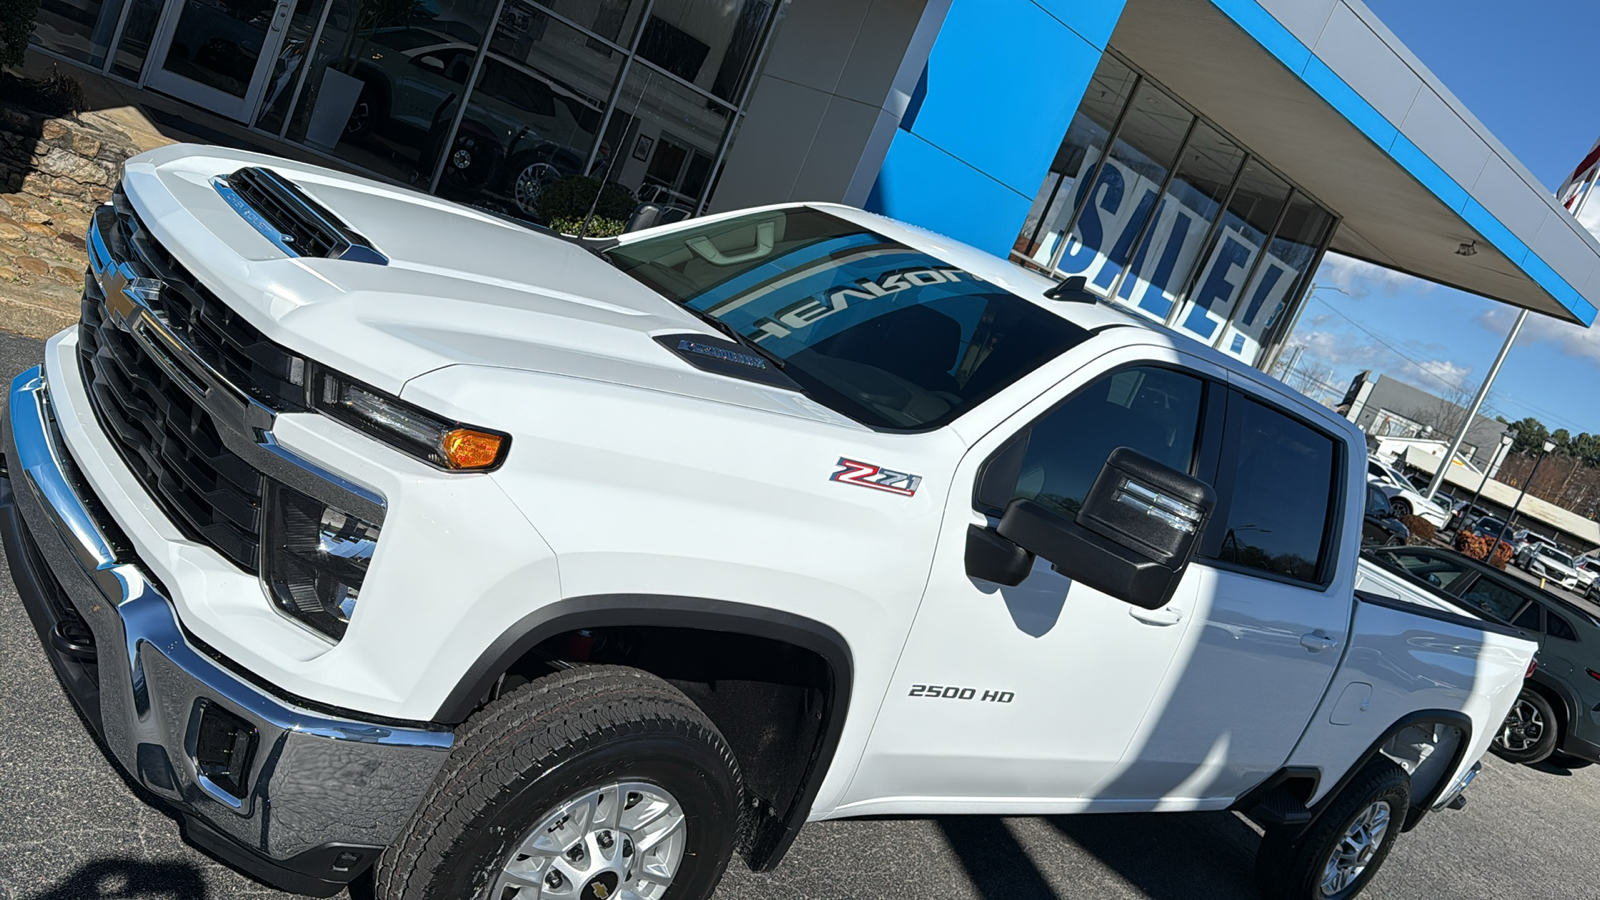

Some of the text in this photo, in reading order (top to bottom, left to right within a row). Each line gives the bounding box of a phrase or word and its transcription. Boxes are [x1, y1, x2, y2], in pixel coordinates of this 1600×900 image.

[1051, 161, 1285, 355] SALE!
[828, 456, 922, 497] Z71
[908, 684, 1015, 703] 2500 HD
